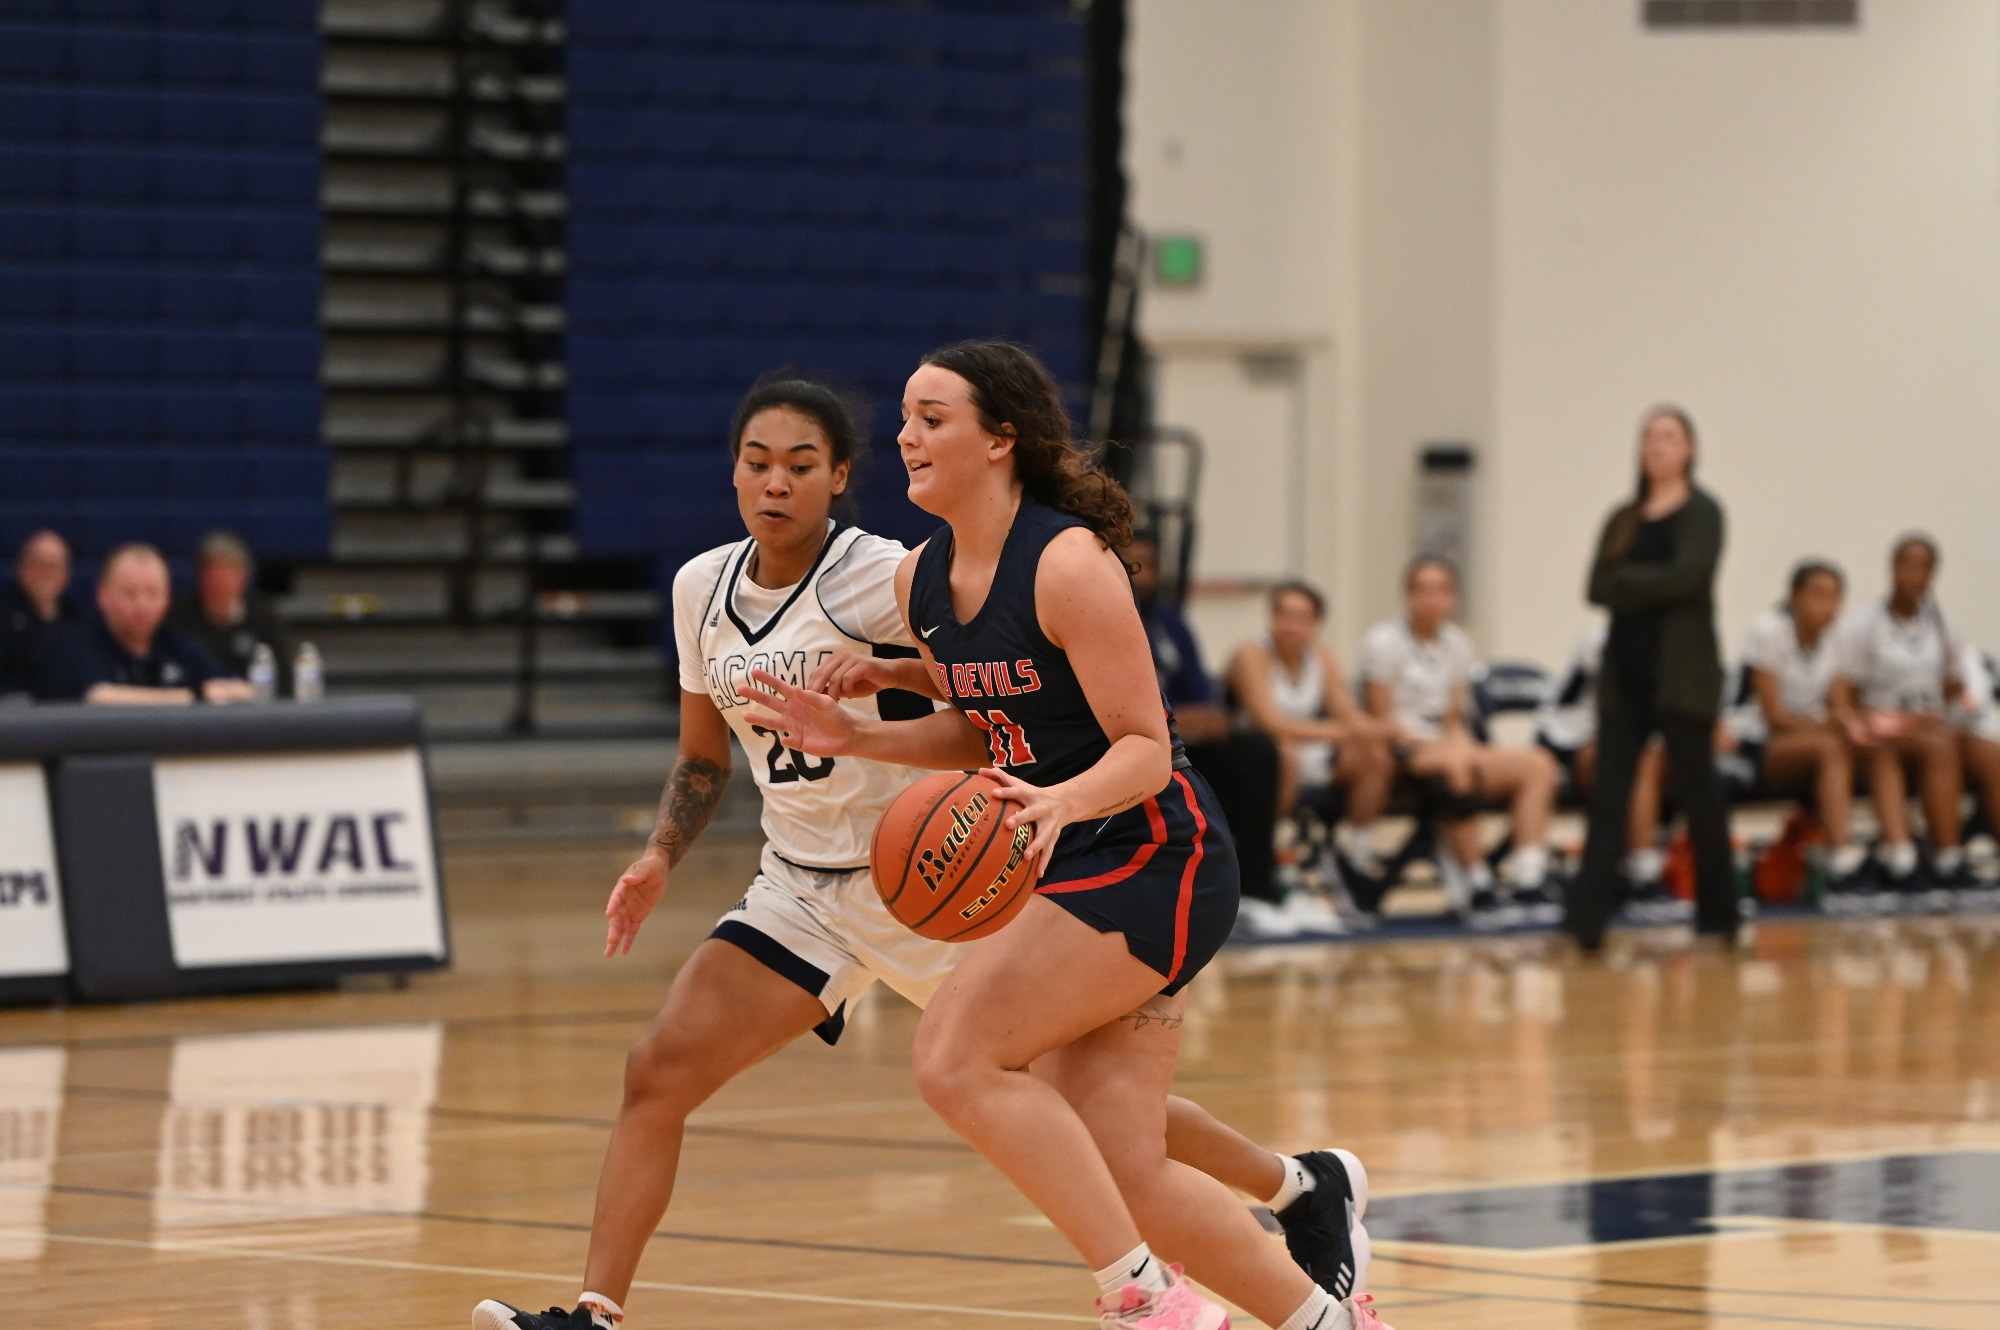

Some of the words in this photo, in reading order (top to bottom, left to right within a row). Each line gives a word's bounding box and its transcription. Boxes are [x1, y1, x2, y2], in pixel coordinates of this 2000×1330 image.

[704, 651, 834, 711] ACOM
[952, 659, 1041, 697] DEVILS
[965, 710, 1037, 767] 11
[176, 811, 414, 880] NWAC
[916, 792, 989, 894] Baden
[959, 848, 1023, 920] ELITE
